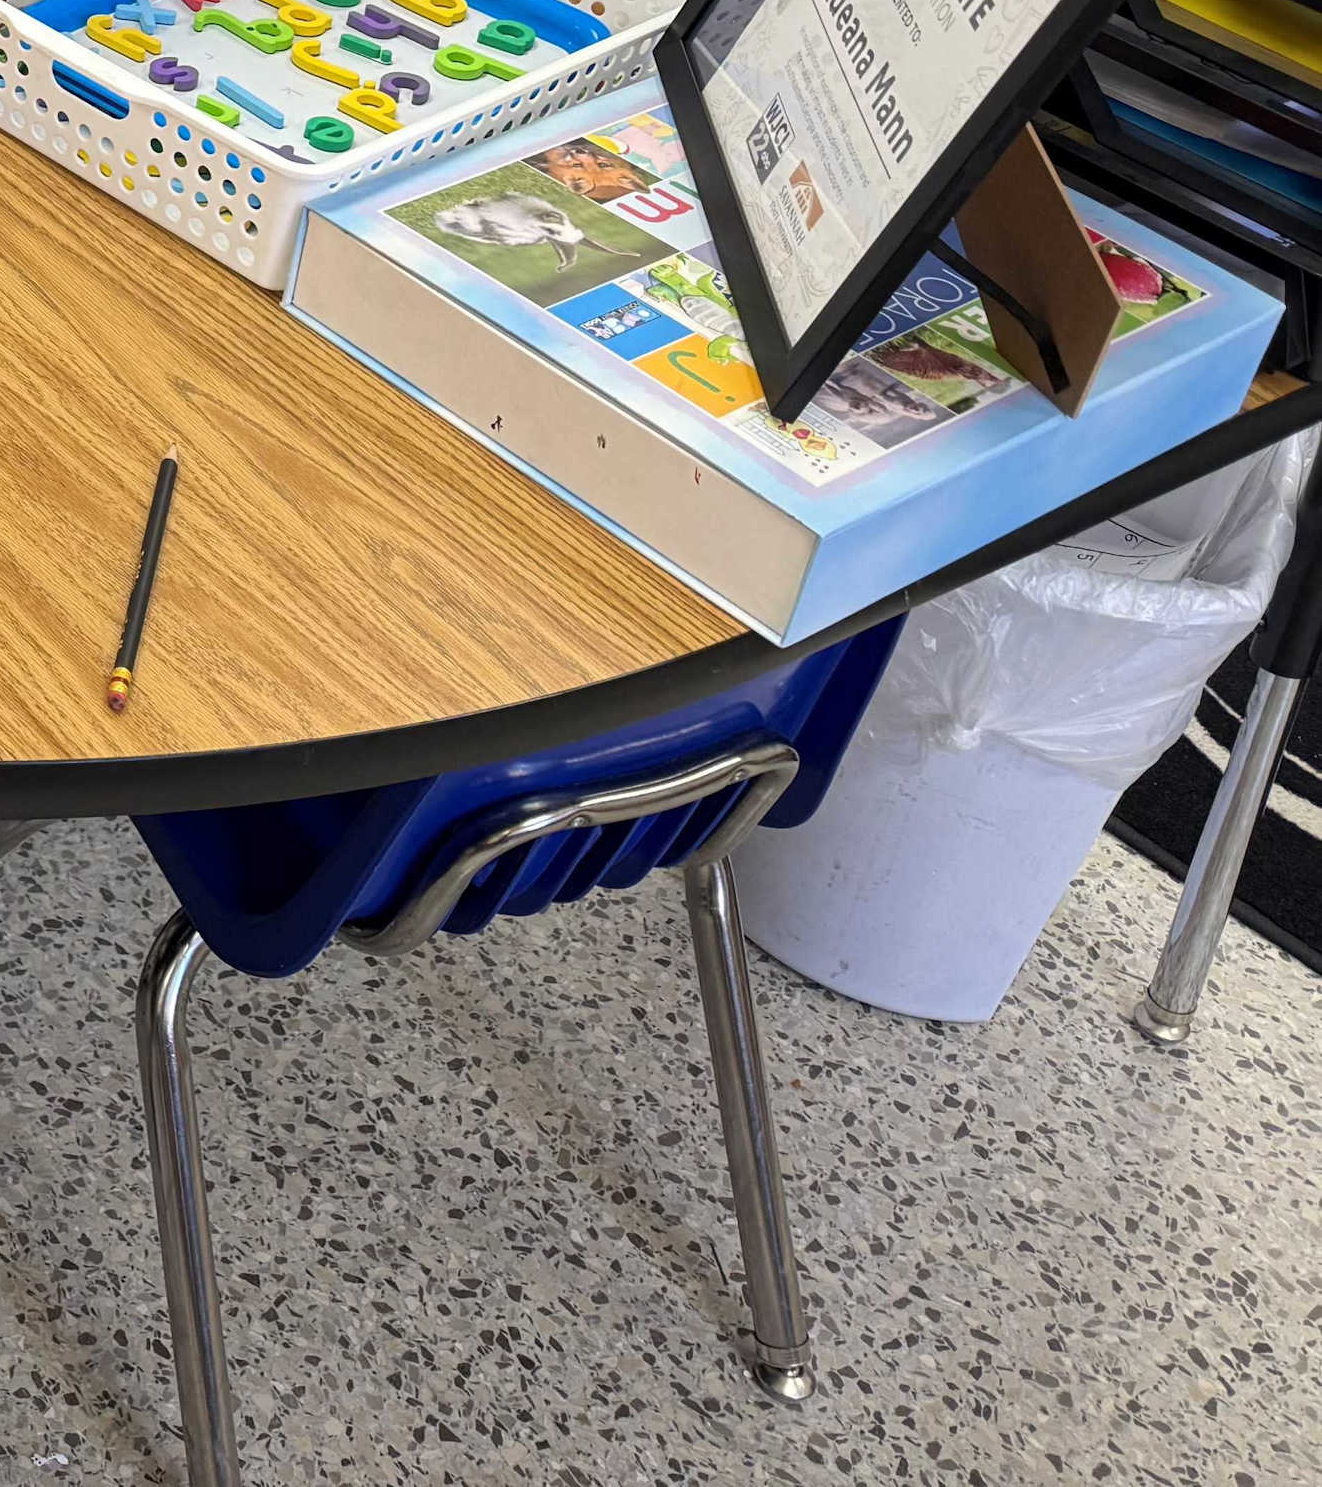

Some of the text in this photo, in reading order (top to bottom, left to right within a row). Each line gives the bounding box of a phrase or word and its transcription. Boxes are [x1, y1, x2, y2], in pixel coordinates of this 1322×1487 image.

[766, 99, 791, 153] WJCL
[865, 61, 913, 163] Mann
[779, 185, 805, 246] SAVANNAH
